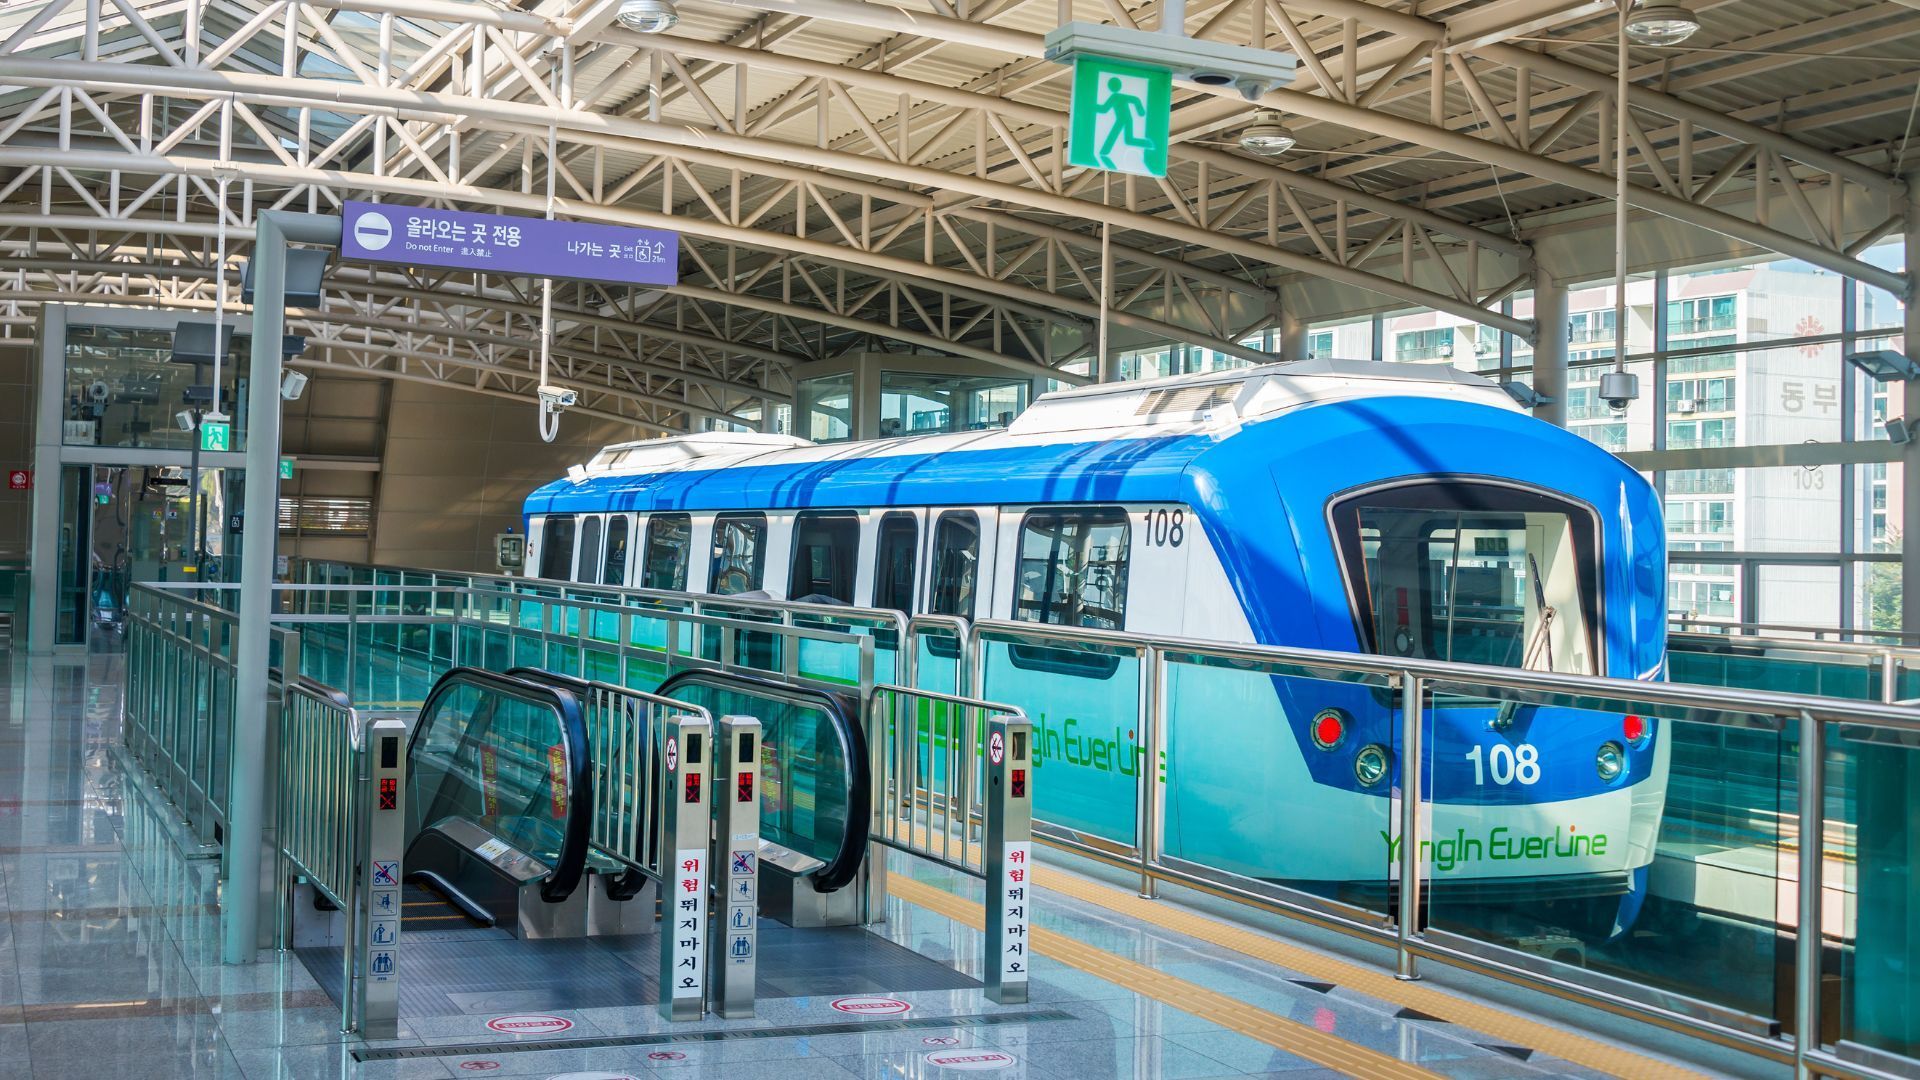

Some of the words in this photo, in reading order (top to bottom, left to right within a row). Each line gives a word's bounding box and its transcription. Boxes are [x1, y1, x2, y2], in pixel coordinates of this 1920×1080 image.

[405, 241, 417, 250] Do
[418, 243, 432, 252] not
[433, 244, 454, 254] Enter
[406, 216, 466, 242] 올라오는
[471, 223, 487, 244] 곳
[492, 225, 522, 248] 전용
[567, 240, 604, 257] 나가는
[608, 244, 622, 258] 곳
[651, 255, 666, 263] 21m
[1781, 381, 1838, 414] 동부
[1793, 468, 1824, 490] 103
[1144, 508, 1184, 548] 108
[1465, 743, 1541, 786] 108
[1380, 828, 1482, 871] YngIn
[1489, 825, 1608, 860] EverLine
[681, 858, 699, 893] 위험
[1008, 850, 1025, 882] 위험
